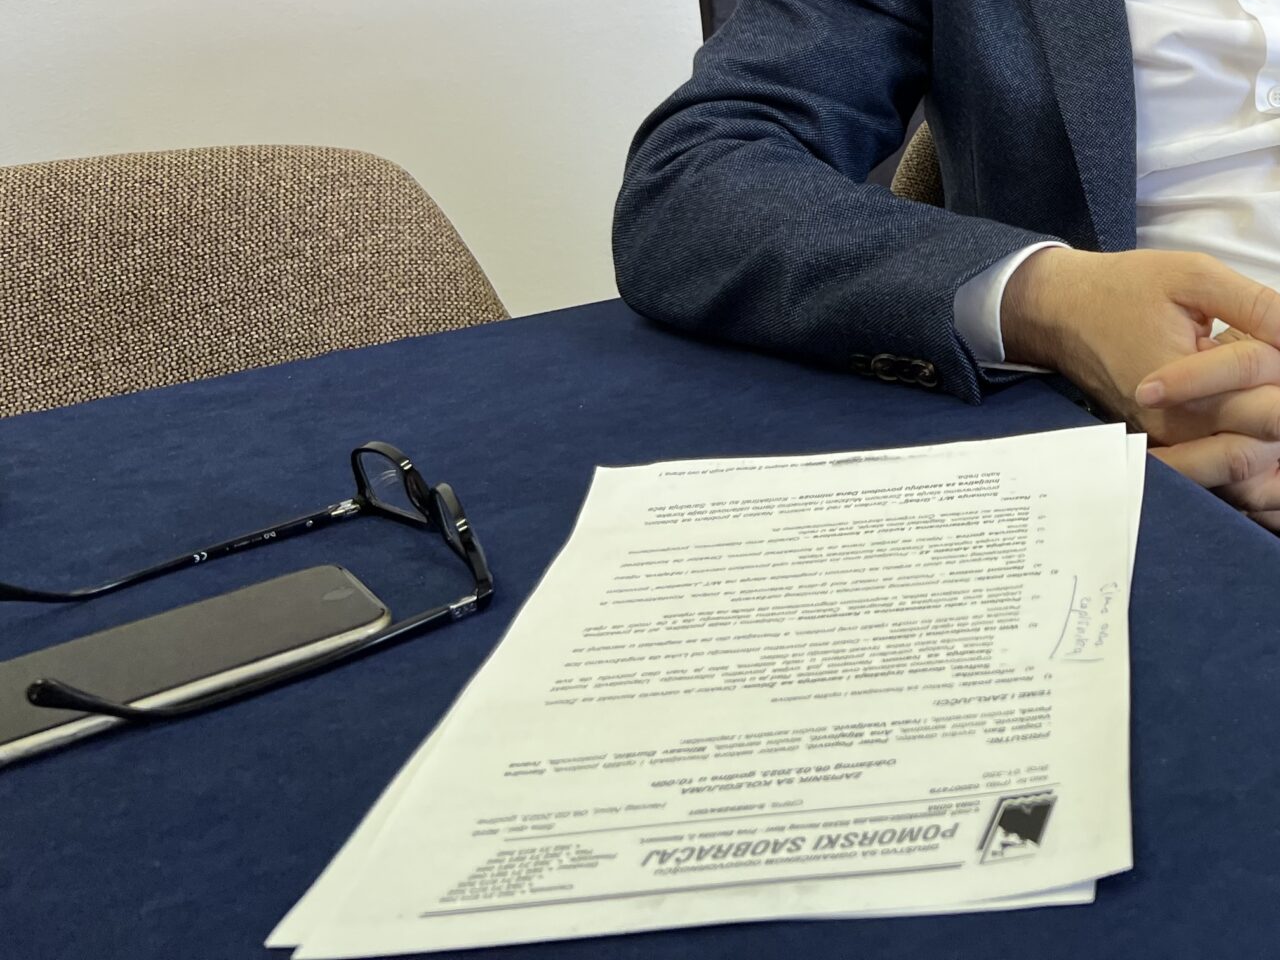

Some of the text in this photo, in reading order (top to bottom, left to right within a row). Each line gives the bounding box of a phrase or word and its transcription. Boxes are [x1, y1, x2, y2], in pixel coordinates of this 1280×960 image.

[709, 772, 757, 781] godine
[797, 772, 862, 784] ZAPISNIK
[811, 823, 959, 851] POMORSKI
[640, 836, 807, 866] SAOBRAĆAJ
